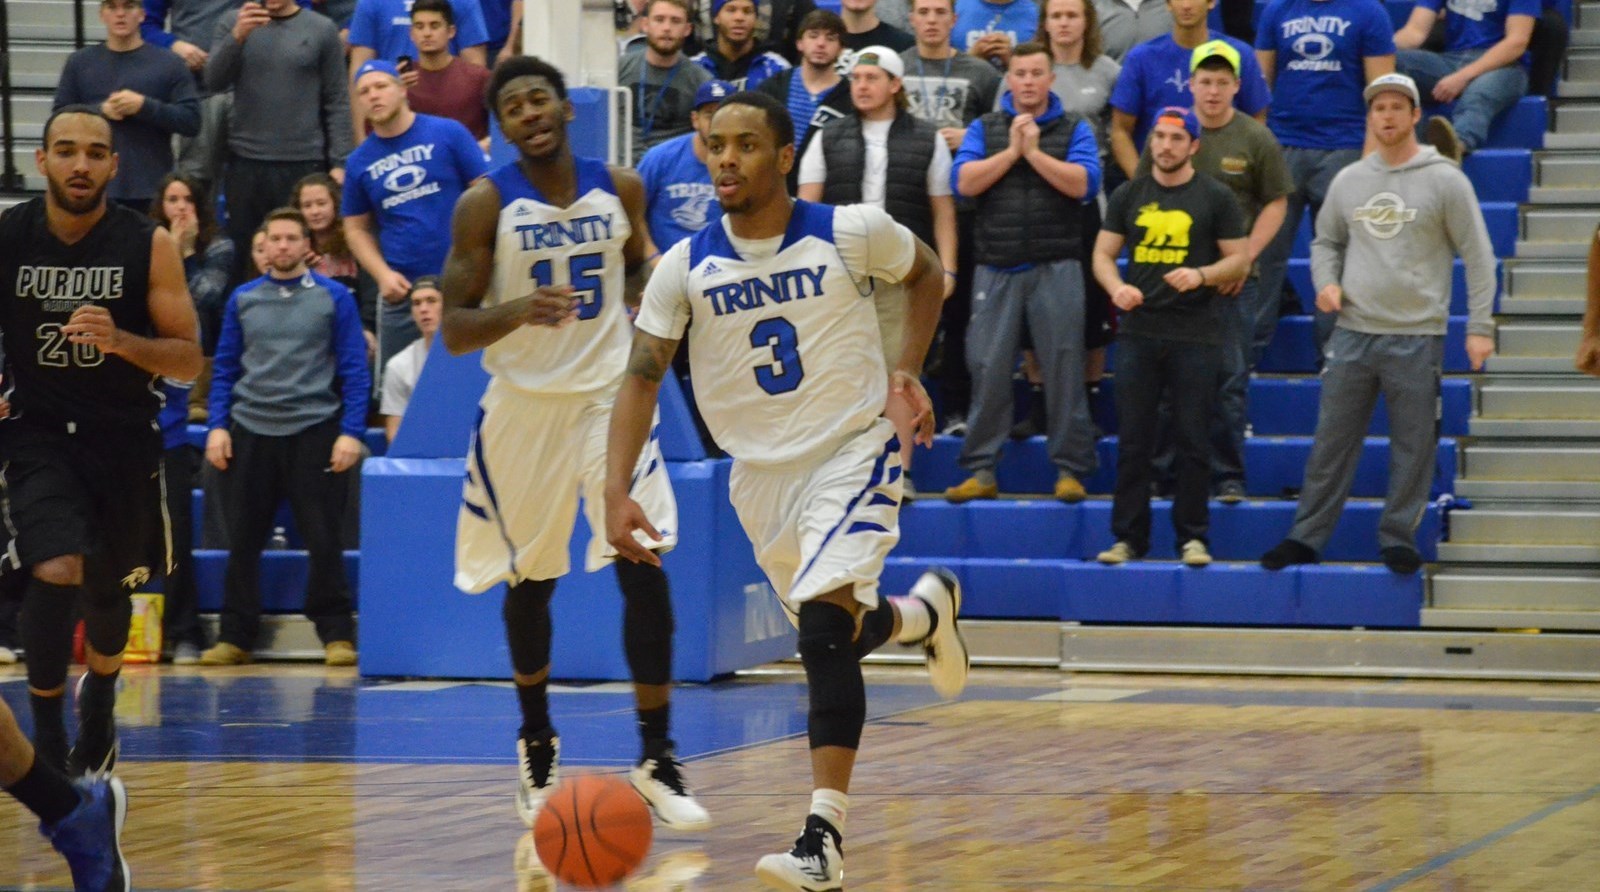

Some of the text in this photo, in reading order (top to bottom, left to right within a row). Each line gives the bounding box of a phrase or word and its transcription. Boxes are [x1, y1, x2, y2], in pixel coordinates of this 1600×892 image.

[1281, 15, 1352, 39] TRINITY
[365, 143, 435, 180] TRINITY
[514, 213, 613, 251] TRINITY
[1134, 245, 1188, 265] Beer
[16, 265, 124, 299] PURDUE
[703, 264, 827, 316] TRINITY
[749, 316, 805, 396] 3
